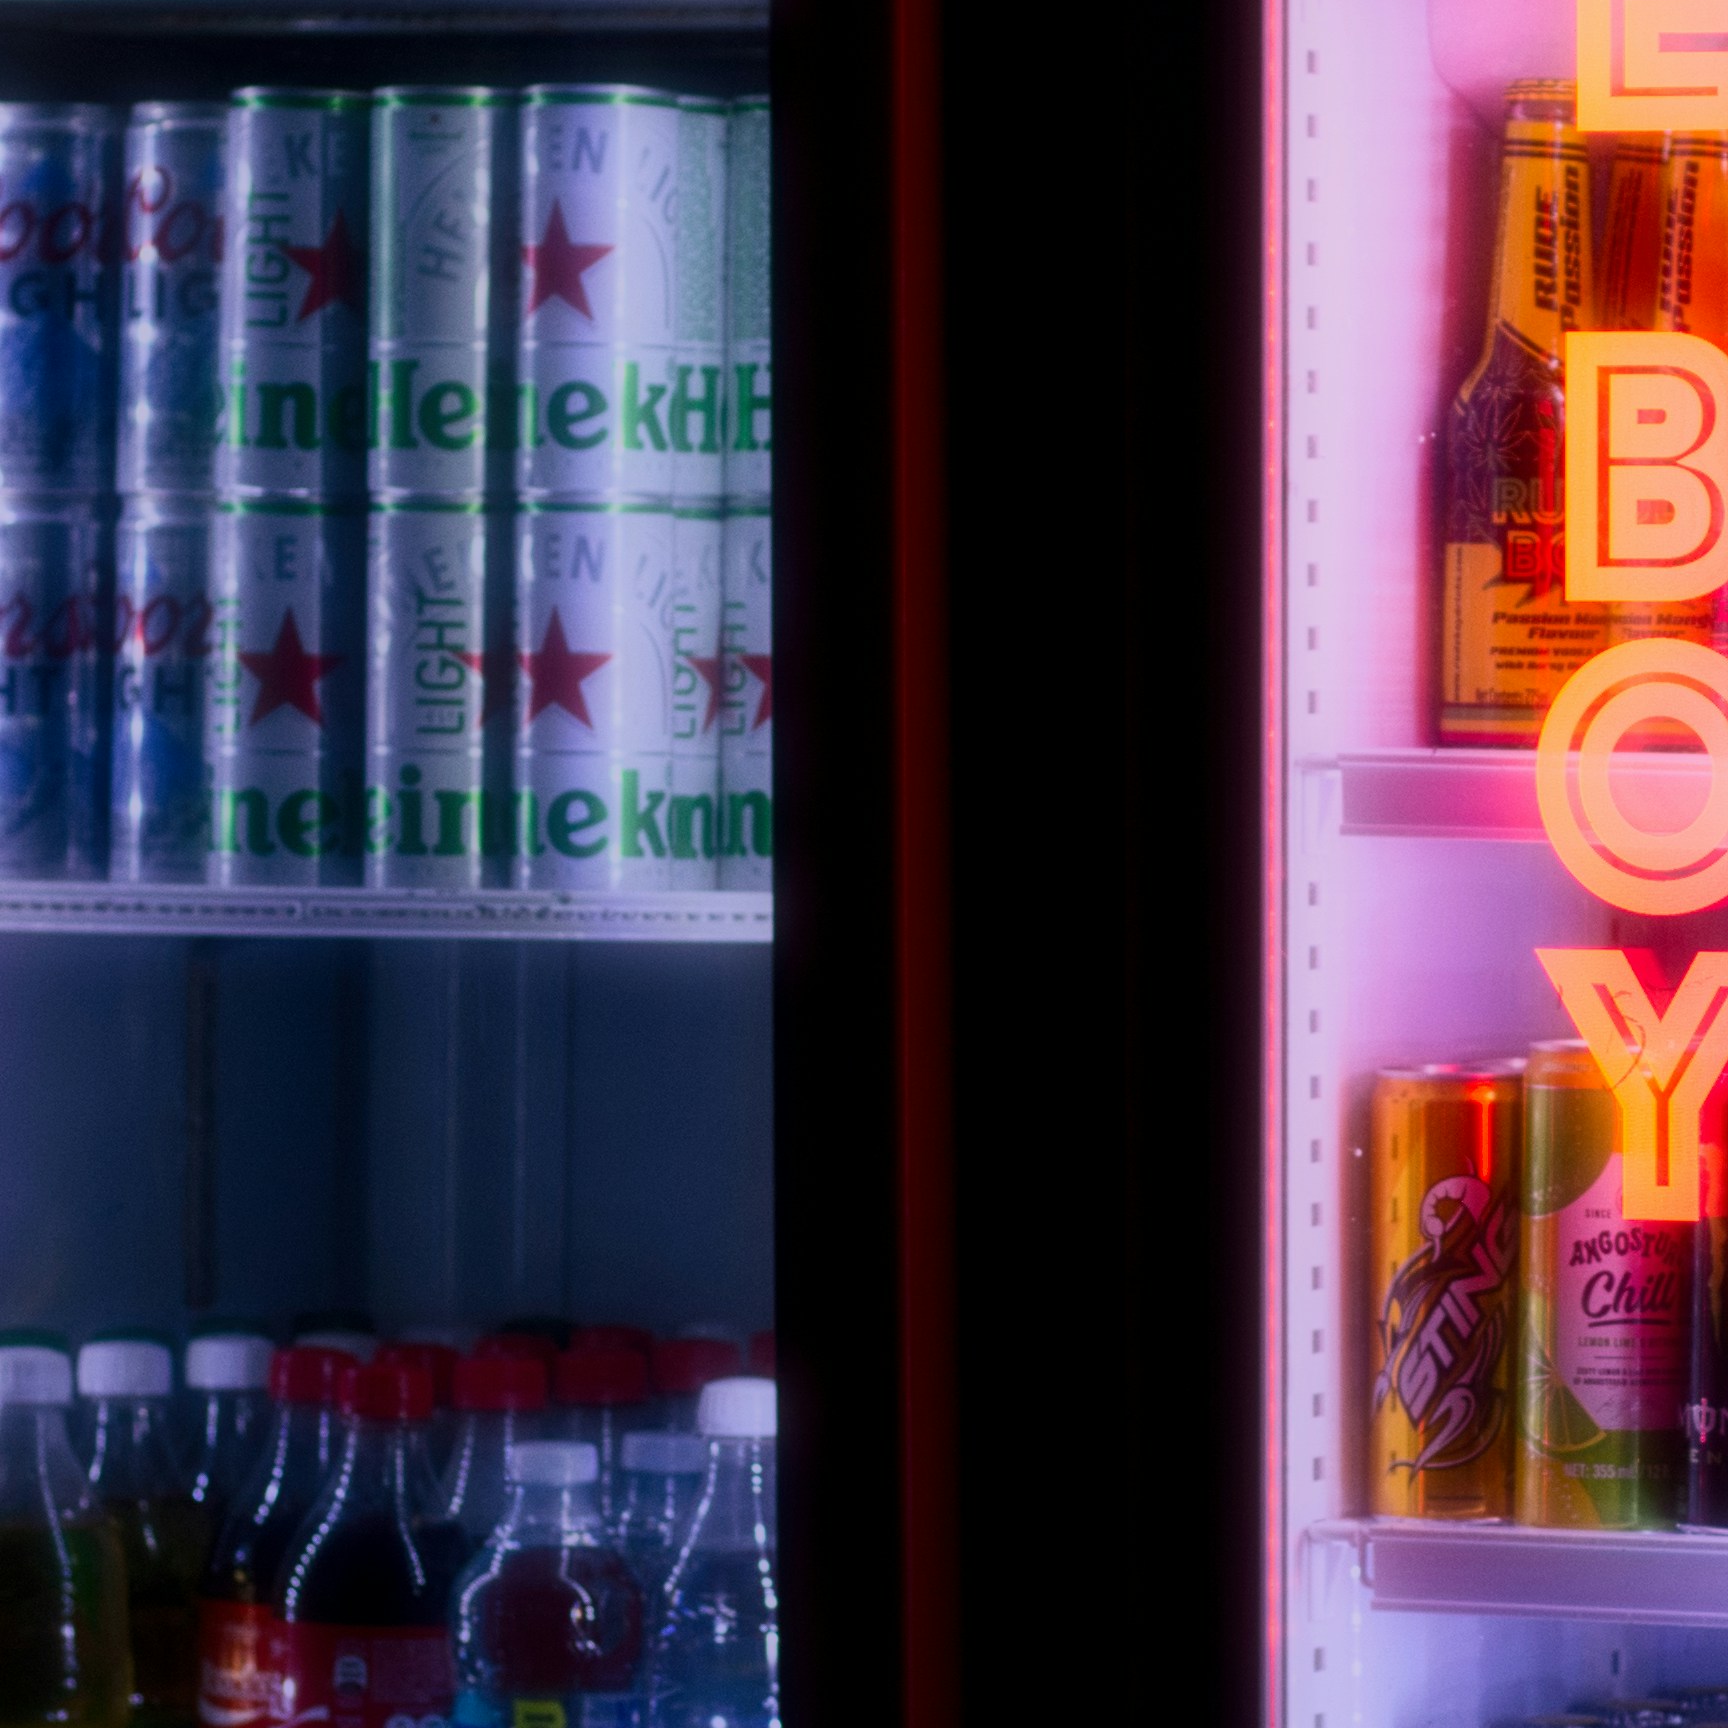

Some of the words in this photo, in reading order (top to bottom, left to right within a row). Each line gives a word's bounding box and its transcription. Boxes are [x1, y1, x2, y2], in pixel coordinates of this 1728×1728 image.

[245, 191, 291, 330] LIGHT
[415, 589, 466, 736] LIGHT
[1581, 1270, 1677, 1320] Chill
